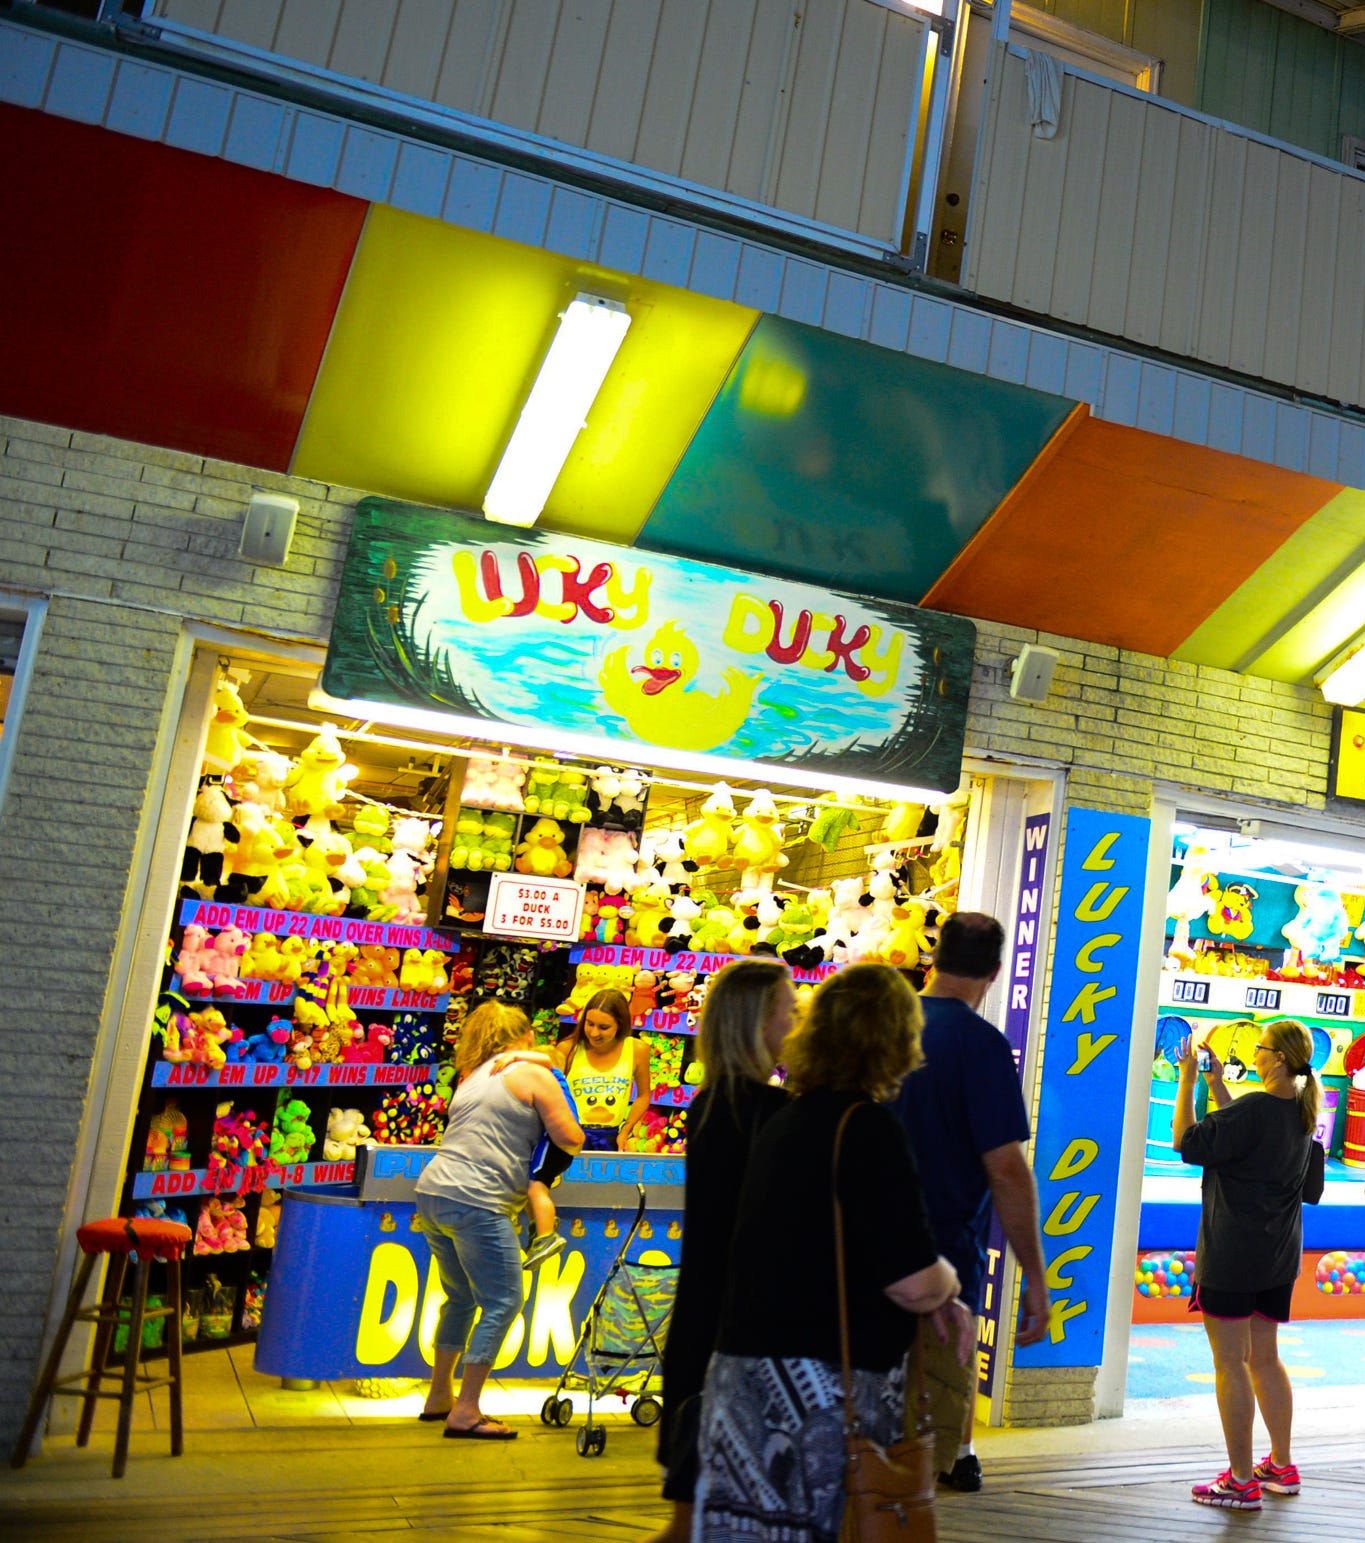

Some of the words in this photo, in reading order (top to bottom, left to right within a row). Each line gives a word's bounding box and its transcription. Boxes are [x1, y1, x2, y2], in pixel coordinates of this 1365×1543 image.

[452, 549, 652, 631] LUCKY
[722, 592, 905, 698] DUCKY
[518, 888, 547, 901] $3.00
[553, 892, 560, 902] A
[523, 902, 551, 914] DUCK
[194, 904, 233, 927] ADD
[235, 911, 259, 931] EM
[263, 912, 286, 935] UP
[288, 914, 307, 936] 22
[310, 918, 342, 940] AND
[346, 921, 384, 945] OVER
[387, 925, 422, 948] WINS
[500, 913, 507, 924] 3
[512, 914, 534, 926] FOR
[540, 916, 569, 930] $5.00
[1011, 825, 1048, 1010] WINNER
[581, 945, 616, 963] ADD
[620, 948, 644, 966] EM
[648, 950, 673, 968] UP
[677, 952, 696, 970] 22
[1061, 832, 1129, 1076] LUCKY
[269, 982, 292, 1002] UP
[347, 987, 386, 1007] WINS
[391, 989, 438, 1009] LARGE
[653, 1011, 680, 1031] UP
[168, 1064, 209, 1084] ADD
[218, 1065, 246, 1085] EM
[253, 1065, 279, 1085] UP
[286, 1065, 320, 1085] 9-17
[328, 1065, 367, 1085] WINS
[373, 1065, 430, 1084] MEDIUM
[151, 1173, 196, 1195] ADD
[279, 1164, 304, 1186] 1-8
[314, 1162, 355, 1184] WINS
[1043, 1138, 1101, 1344] DUCK
[977, 1248, 1001, 1382] TIME
